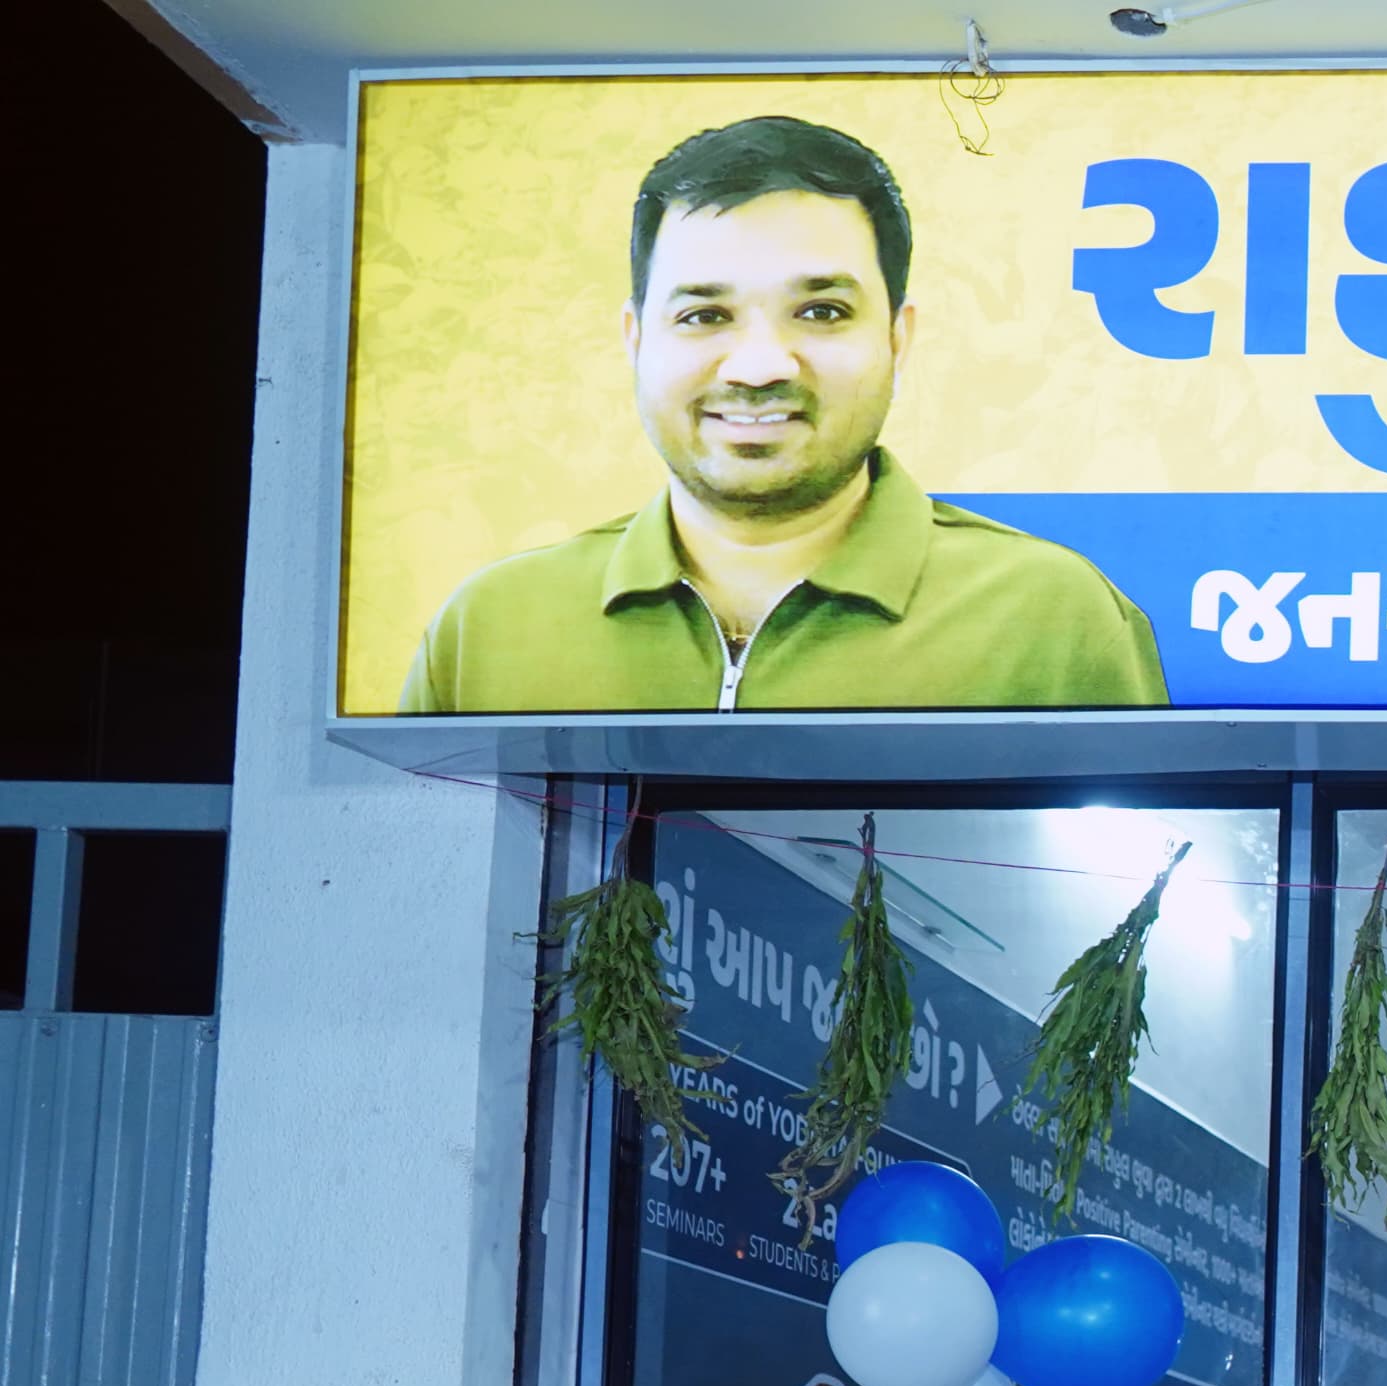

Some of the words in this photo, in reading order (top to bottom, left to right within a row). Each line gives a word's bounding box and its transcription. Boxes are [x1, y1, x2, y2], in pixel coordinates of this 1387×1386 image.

[705, 908, 793, 1024] આપ
[743, 1096, 765, 1129] of
[650, 1124, 727, 1194] 207+
[646, 1199, 726, 1248] SEMINARS
[1077, 1188, 1121, 1233] Positive
[1122, 1210, 1174, 1263] Parenting
[749, 1234, 818, 1279] STUDENTS
